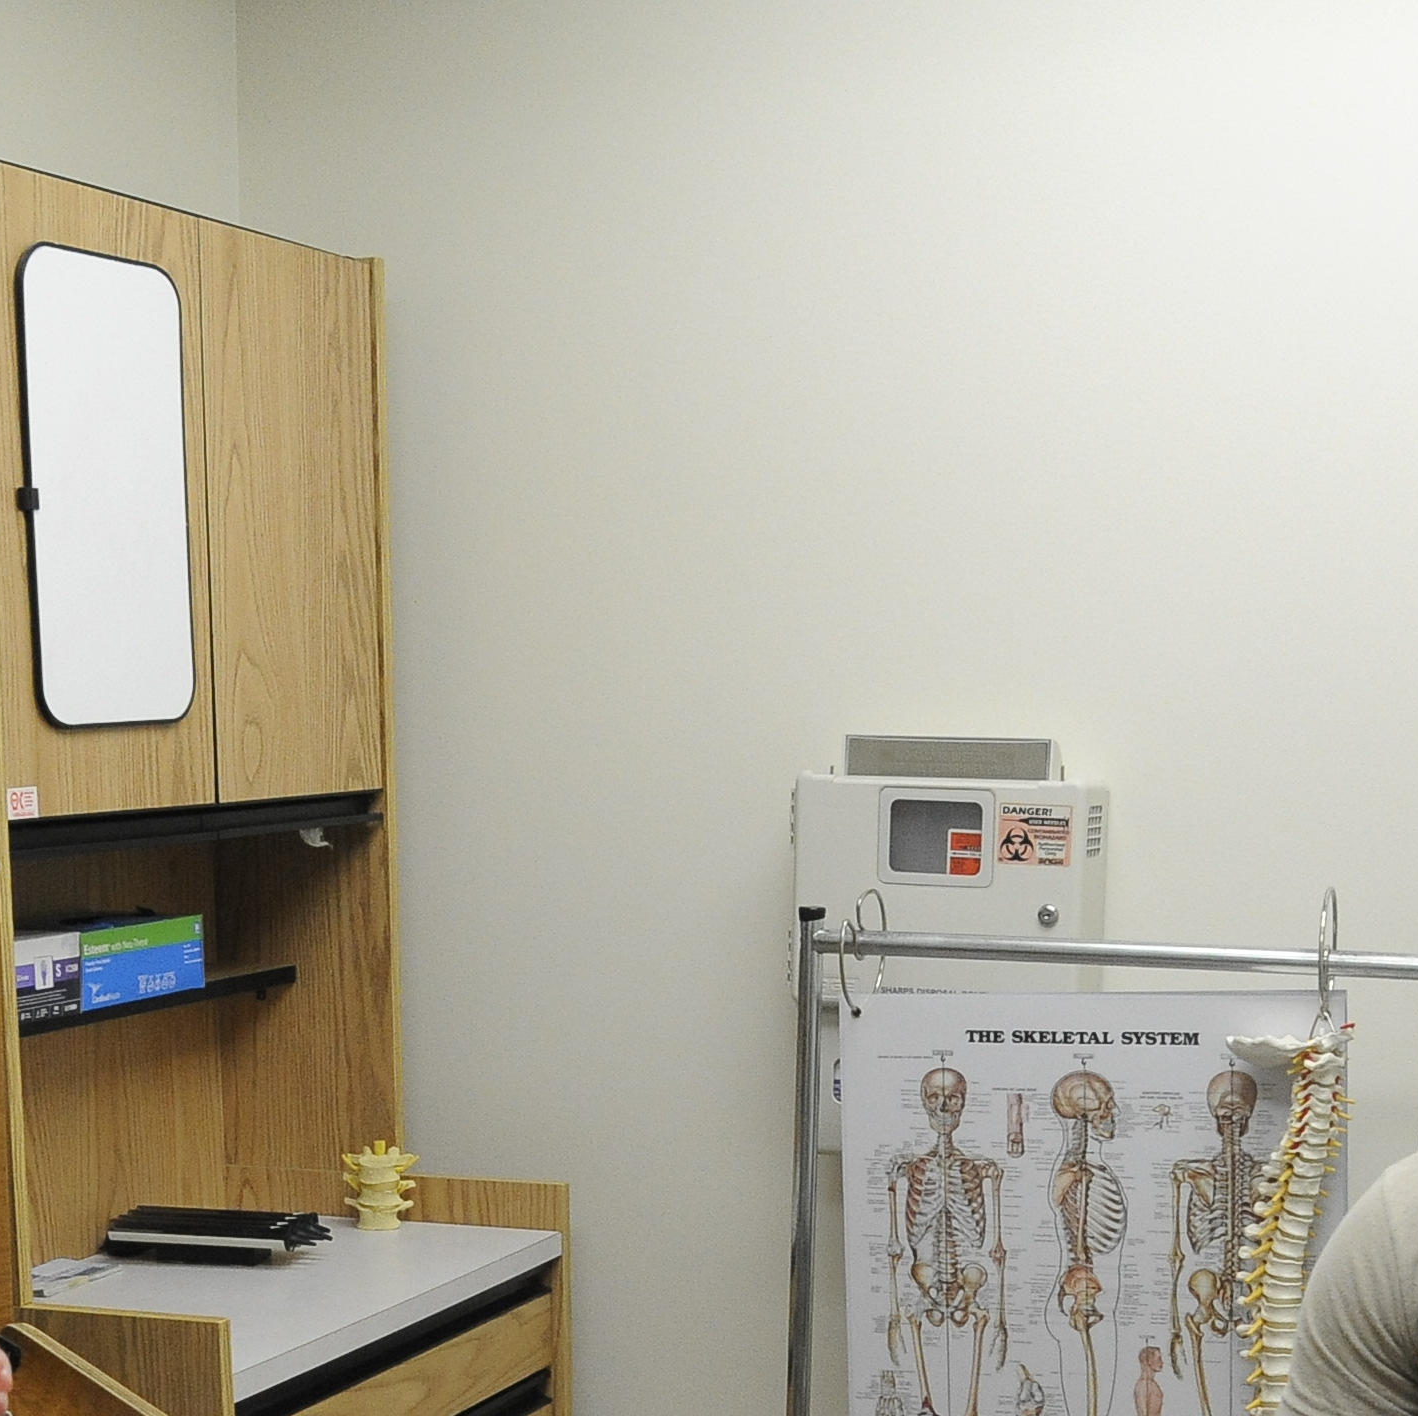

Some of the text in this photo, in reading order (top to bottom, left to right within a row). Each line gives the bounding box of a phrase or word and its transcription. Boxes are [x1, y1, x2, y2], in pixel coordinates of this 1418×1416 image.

[1002, 806, 1053, 817] DANGER!
[55, 963, 62, 978] S
[965, 1029, 1200, 1046] THE SKELETAL SYSTEM
